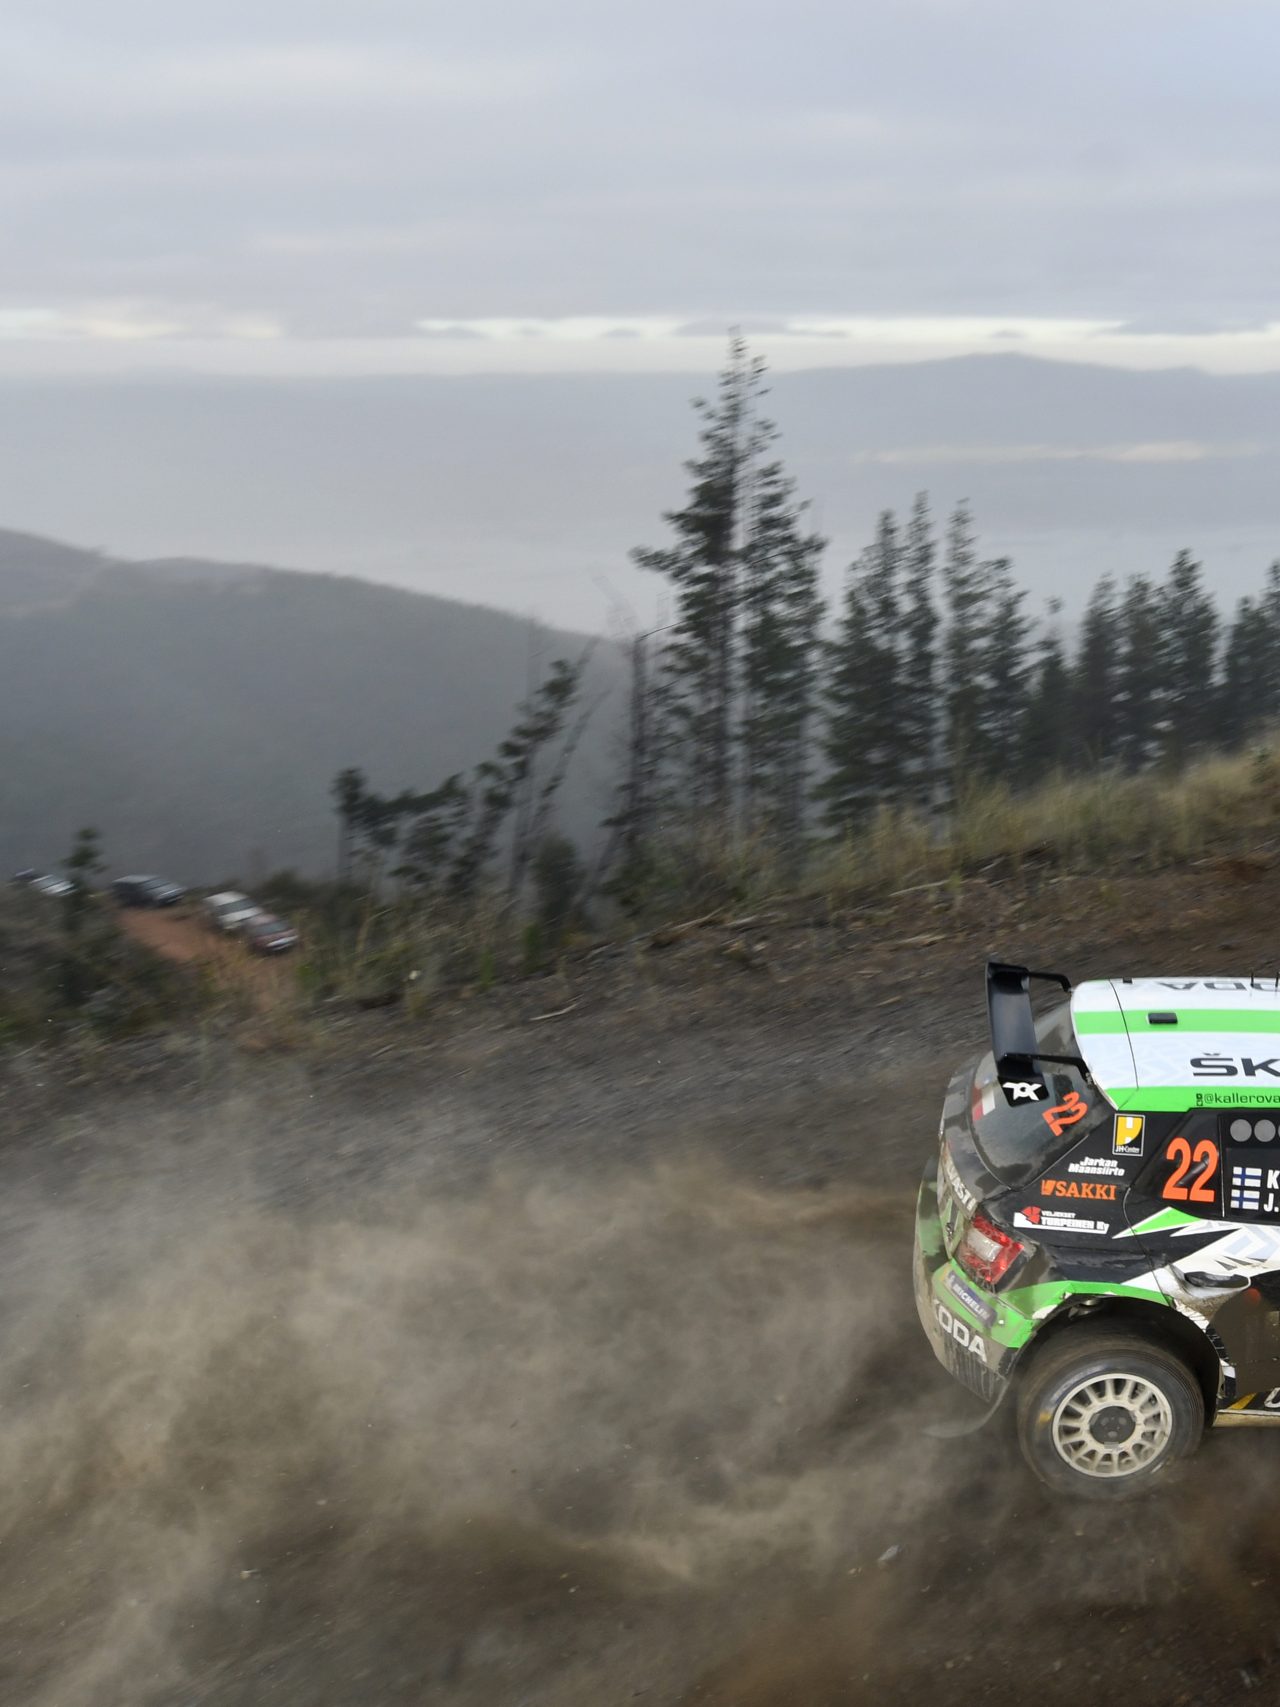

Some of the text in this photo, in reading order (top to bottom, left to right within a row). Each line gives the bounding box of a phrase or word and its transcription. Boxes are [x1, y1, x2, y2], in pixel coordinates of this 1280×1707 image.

[1042, 1091, 1088, 1137] 22
[1068, 1163, 1125, 1177] Maansiirto
[1080, 1156, 1118, 1168] Jarkan
[1162, 1136, 1220, 1203] 22
[1055, 1181, 1117, 1201] SAKKI
